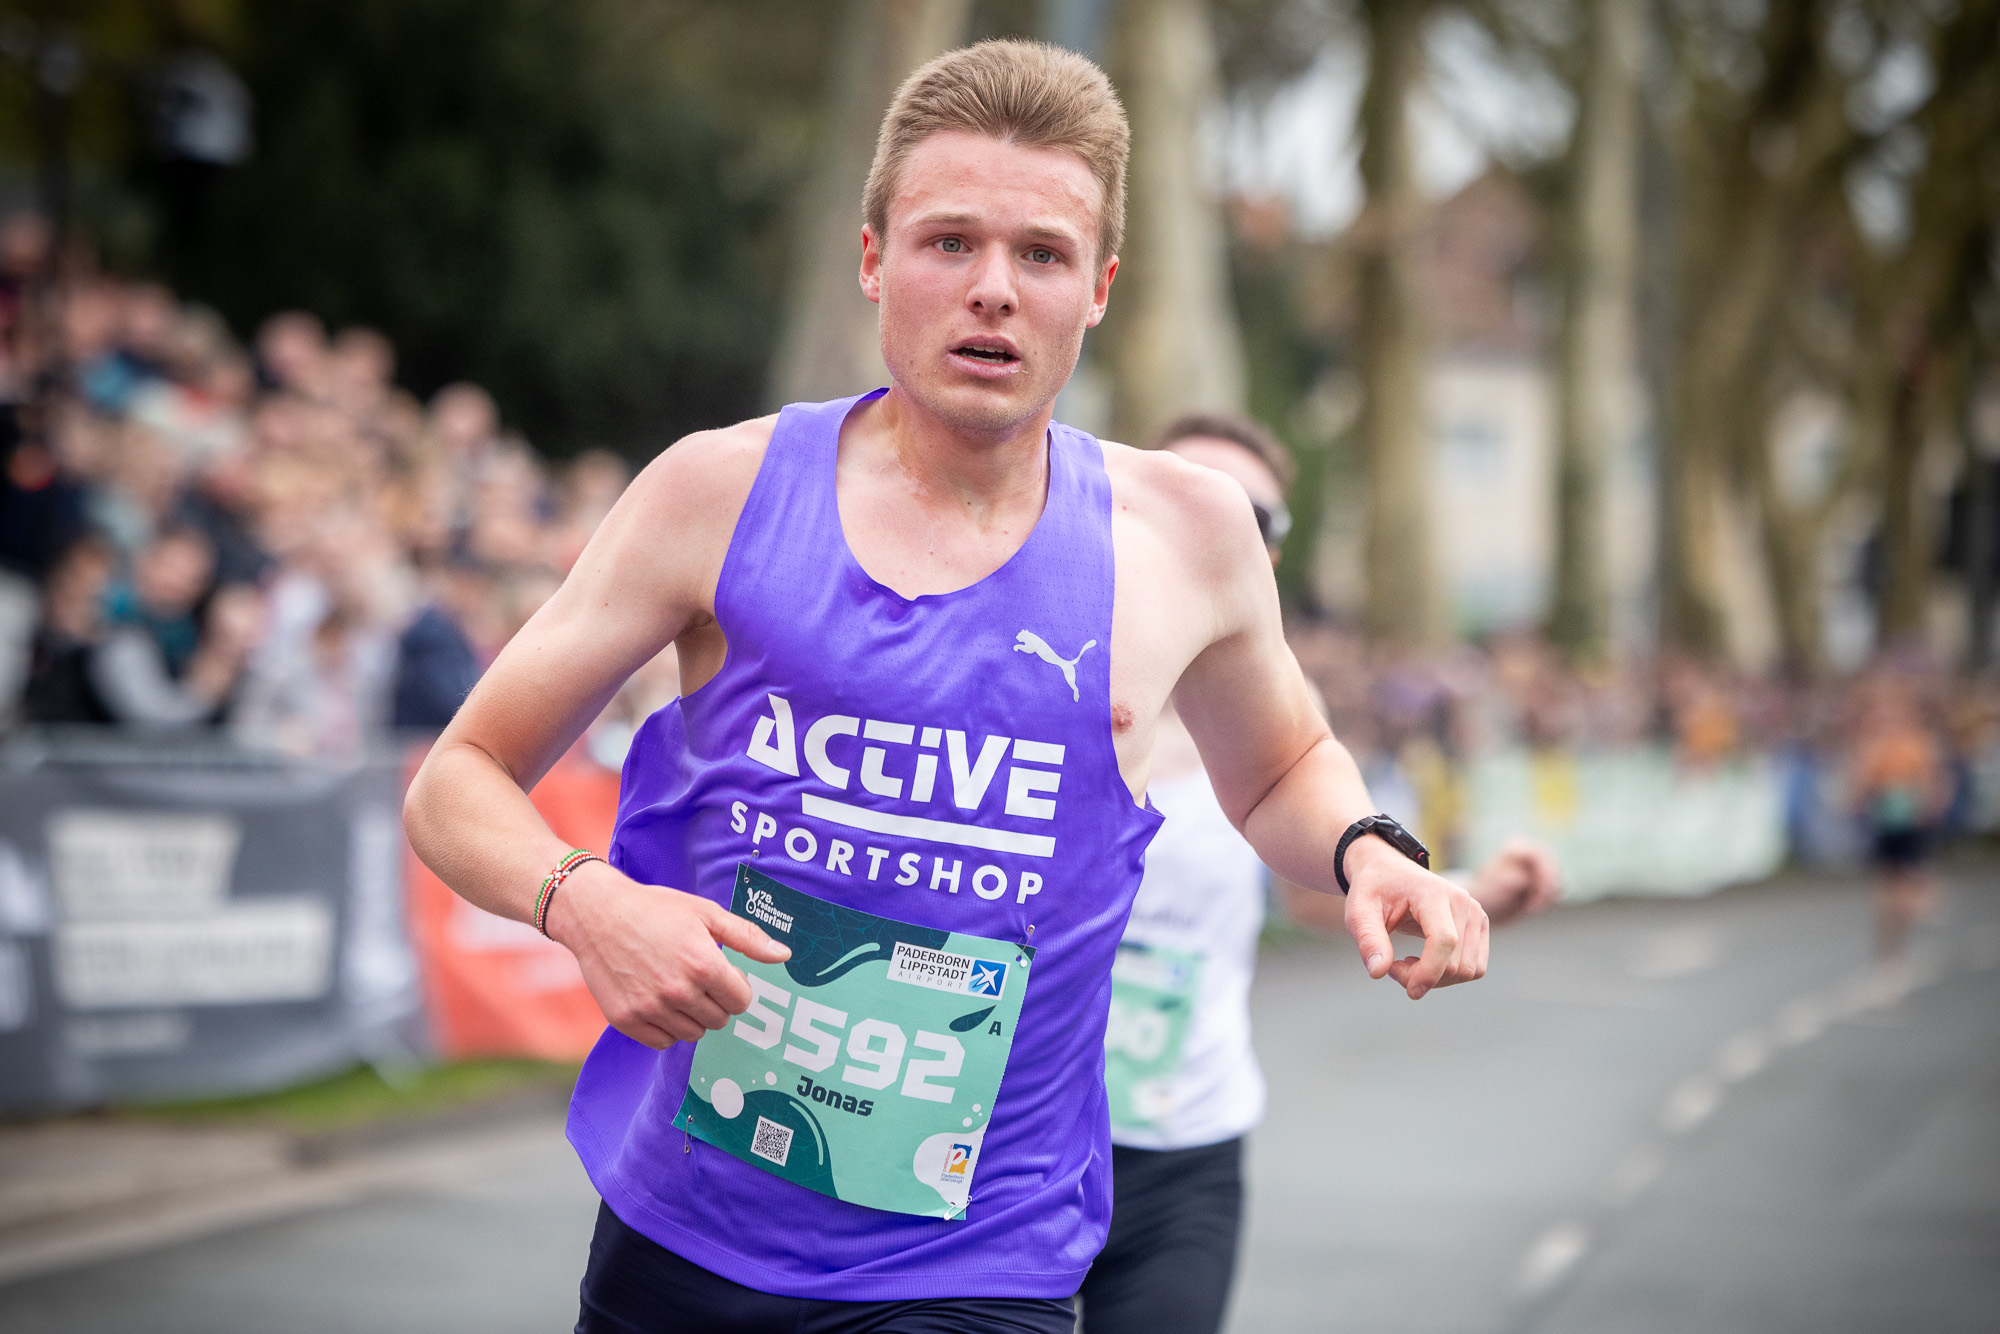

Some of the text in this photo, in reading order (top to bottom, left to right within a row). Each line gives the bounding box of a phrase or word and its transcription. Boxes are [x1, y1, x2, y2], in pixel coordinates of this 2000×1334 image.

[730, 800, 1044, 904] SPORTSHOP
[760, 890, 774, 906] 78.
[757, 899, 794, 923] Paderborner
[897, 945, 971, 969] PADERBORN
[898, 970, 962, 989] AIRPORT
[900, 959, 967, 981] LIPPSTADT
[733, 972, 965, 1104] 5592
[988, 1020, 1002, 1036] A
[796, 1075, 874, 1117] Jonas
